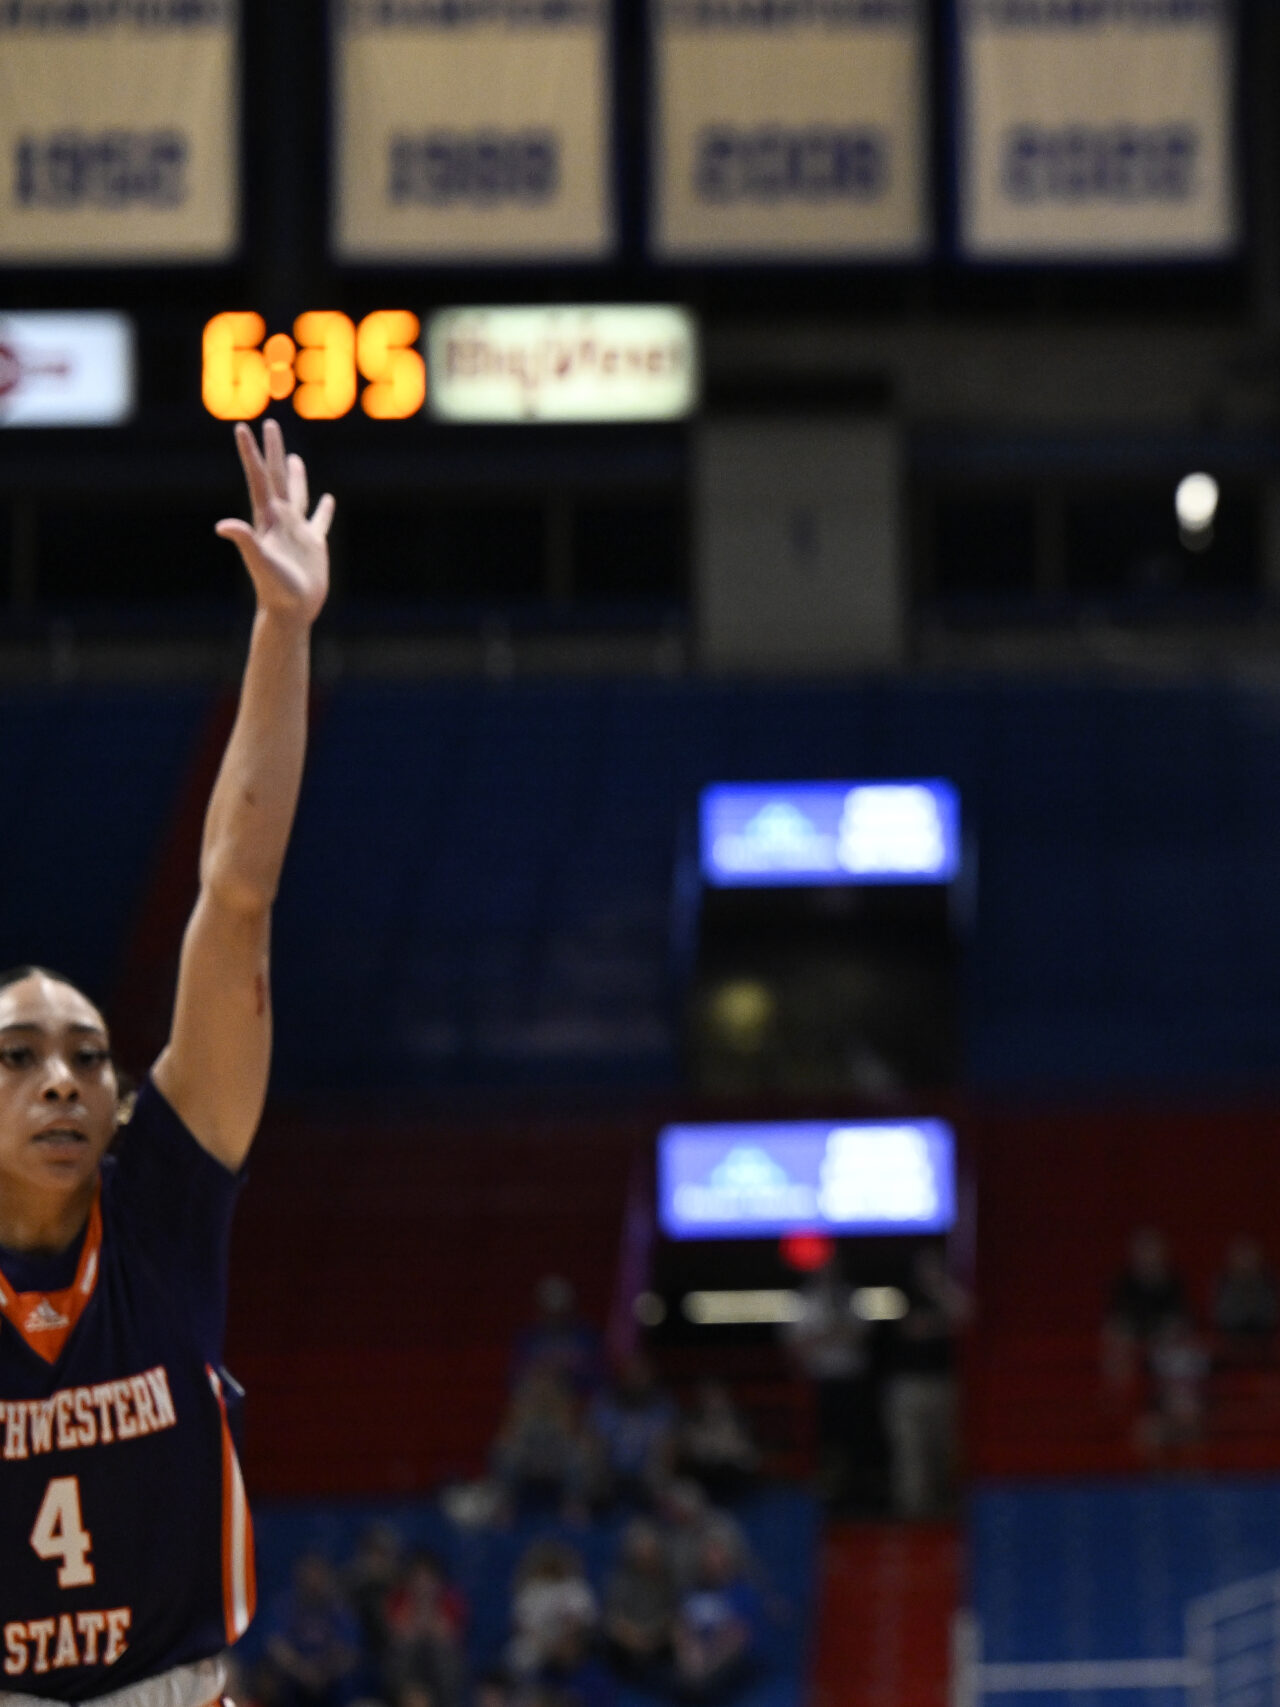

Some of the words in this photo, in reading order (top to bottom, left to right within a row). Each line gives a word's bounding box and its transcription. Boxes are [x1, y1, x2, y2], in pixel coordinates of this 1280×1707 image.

[202, 310, 426, 421] 6:35
[30, 1475, 96, 1590] 4
[3, 1607, 132, 1675] STATE
